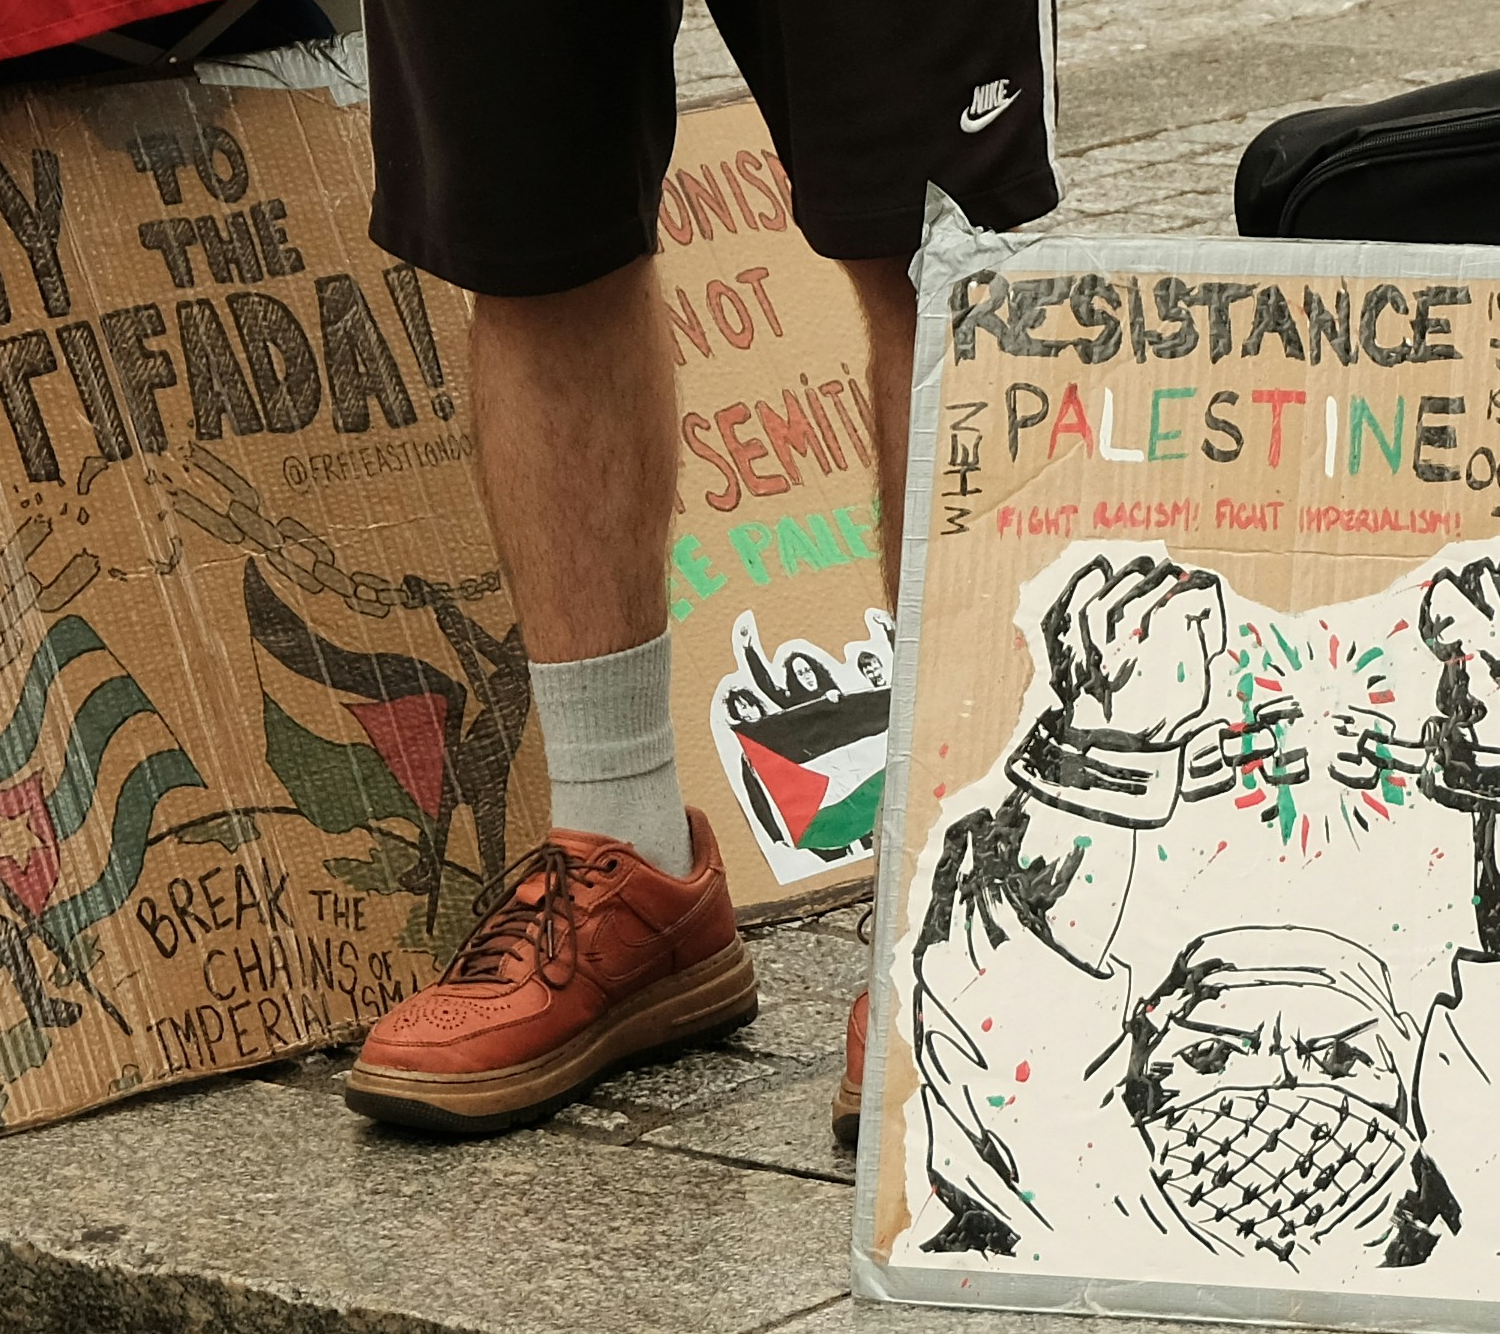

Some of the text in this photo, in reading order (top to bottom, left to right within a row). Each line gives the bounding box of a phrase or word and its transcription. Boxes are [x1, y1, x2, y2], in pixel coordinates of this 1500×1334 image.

[970, 78, 1011, 115] NIKE
[129, 122, 249, 208] TO
[656, 148, 794, 253] ONIS
[138, 198, 308, 294] THE
[666, 266, 783, 367] NOT
[948, 268, 1472, 367] RESISTANCE
[940, 401, 988, 536] WHEN
[1005, 382, 1465, 482] PALESTINE
[727, 497, 883, 586] PALE
[996, 497, 1462, 539] FIGHT RACISM! FIGHT IMPERIALISM!
[136, 857, 368, 960] BREAK THE
[202, 933, 394, 1002] CHAINS OF
